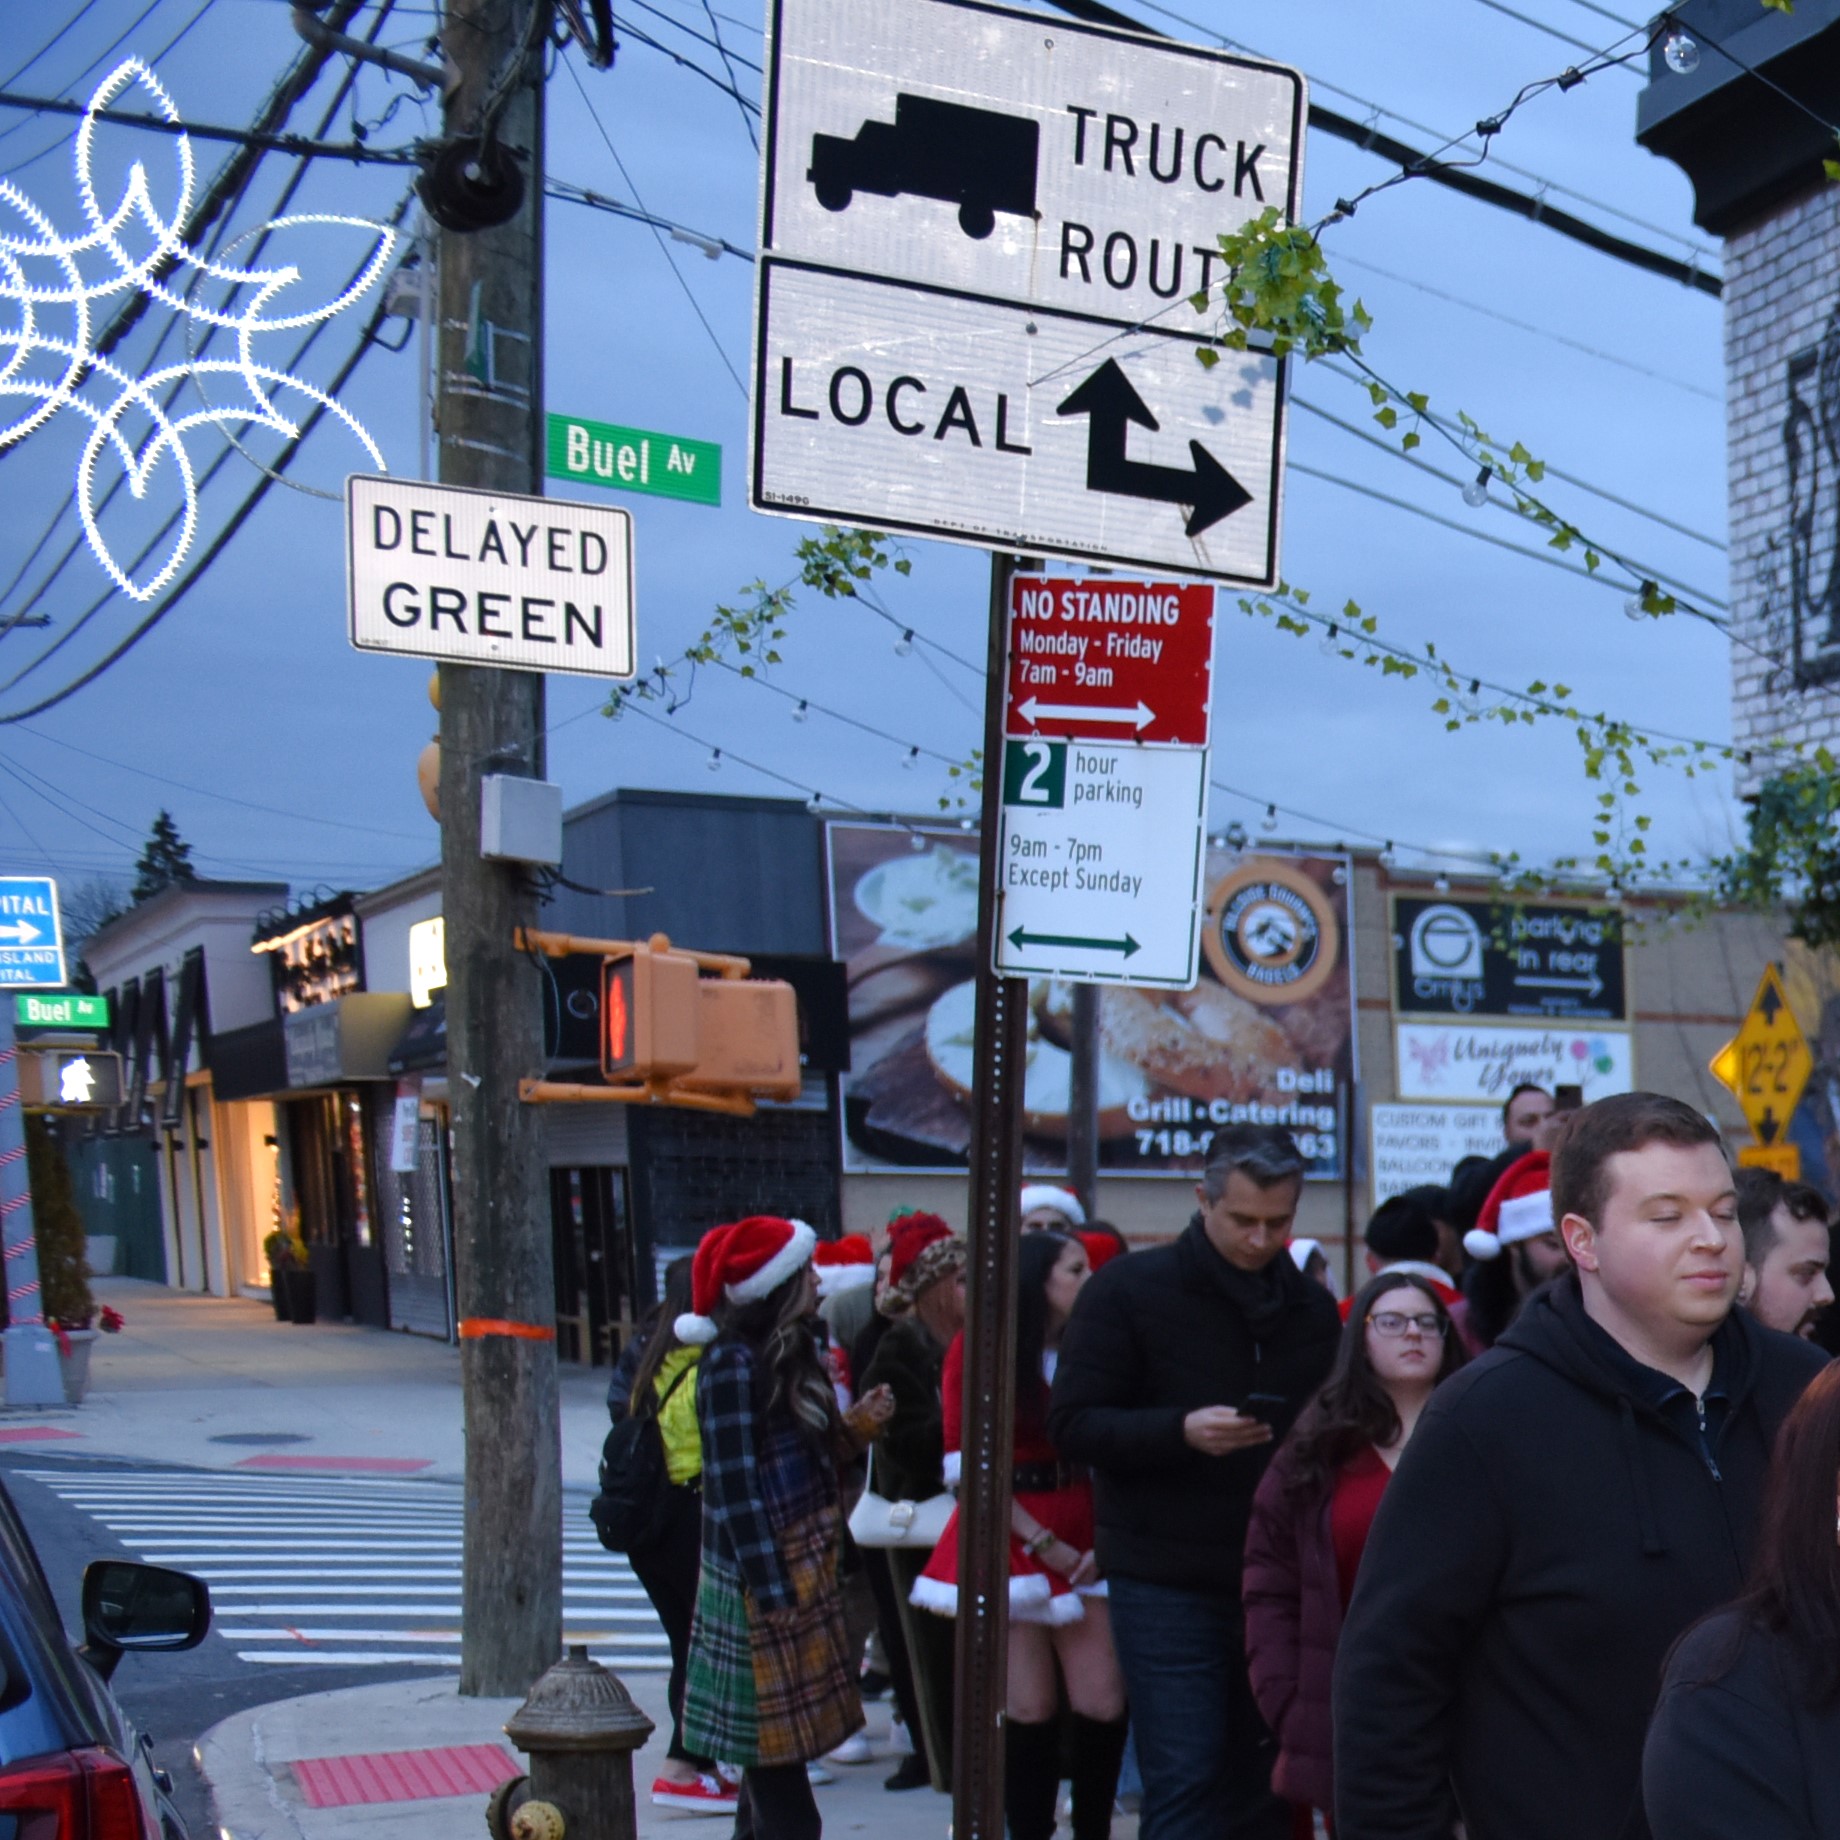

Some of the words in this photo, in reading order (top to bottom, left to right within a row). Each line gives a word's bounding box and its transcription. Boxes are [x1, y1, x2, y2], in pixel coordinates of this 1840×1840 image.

[1066, 104, 1266, 203] TRUCK
[1059, 220, 1245, 312] ROUT
[780, 356, 1033, 457] LOCAL
[567, 424, 649, 485] Buel
[667, 443, 696, 475] Av
[373, 504, 608, 576] DELAYED
[382, 580, 603, 649] GREEN
[1021, 589, 1054, 621] NO
[1060, 592, 1180, 626] STANDING
[1020, 628, 1088, 662] Monday
[1106, 632, 1163, 665] Friday
[1020, 659, 1057, 685] 7am
[1075, 662, 1113, 687] 9am
[1019, 743, 1052, 802] 2
[1076, 751, 1118, 775] hour
[1073, 780, 1143, 810] parking
[1010, 834, 1047, 858] 9am
[1067, 837, 1103, 865] 7pm
[1008, 863, 1069, 892] Except
[1075, 867, 1143, 898] Sunday
[0, 895, 50, 915] ITAL
[0, 950, 56, 964] SLAND
[1518, 946, 1541, 970] in
[1549, 951, 1600, 974] rear
[0, 968, 36, 982] ITAL
[26, 998, 72, 1022] Buel
[1276, 1066, 1335, 1094] Deli
[1127, 1096, 1193, 1123] Grill
[1208, 1097, 1336, 1133] Catering
